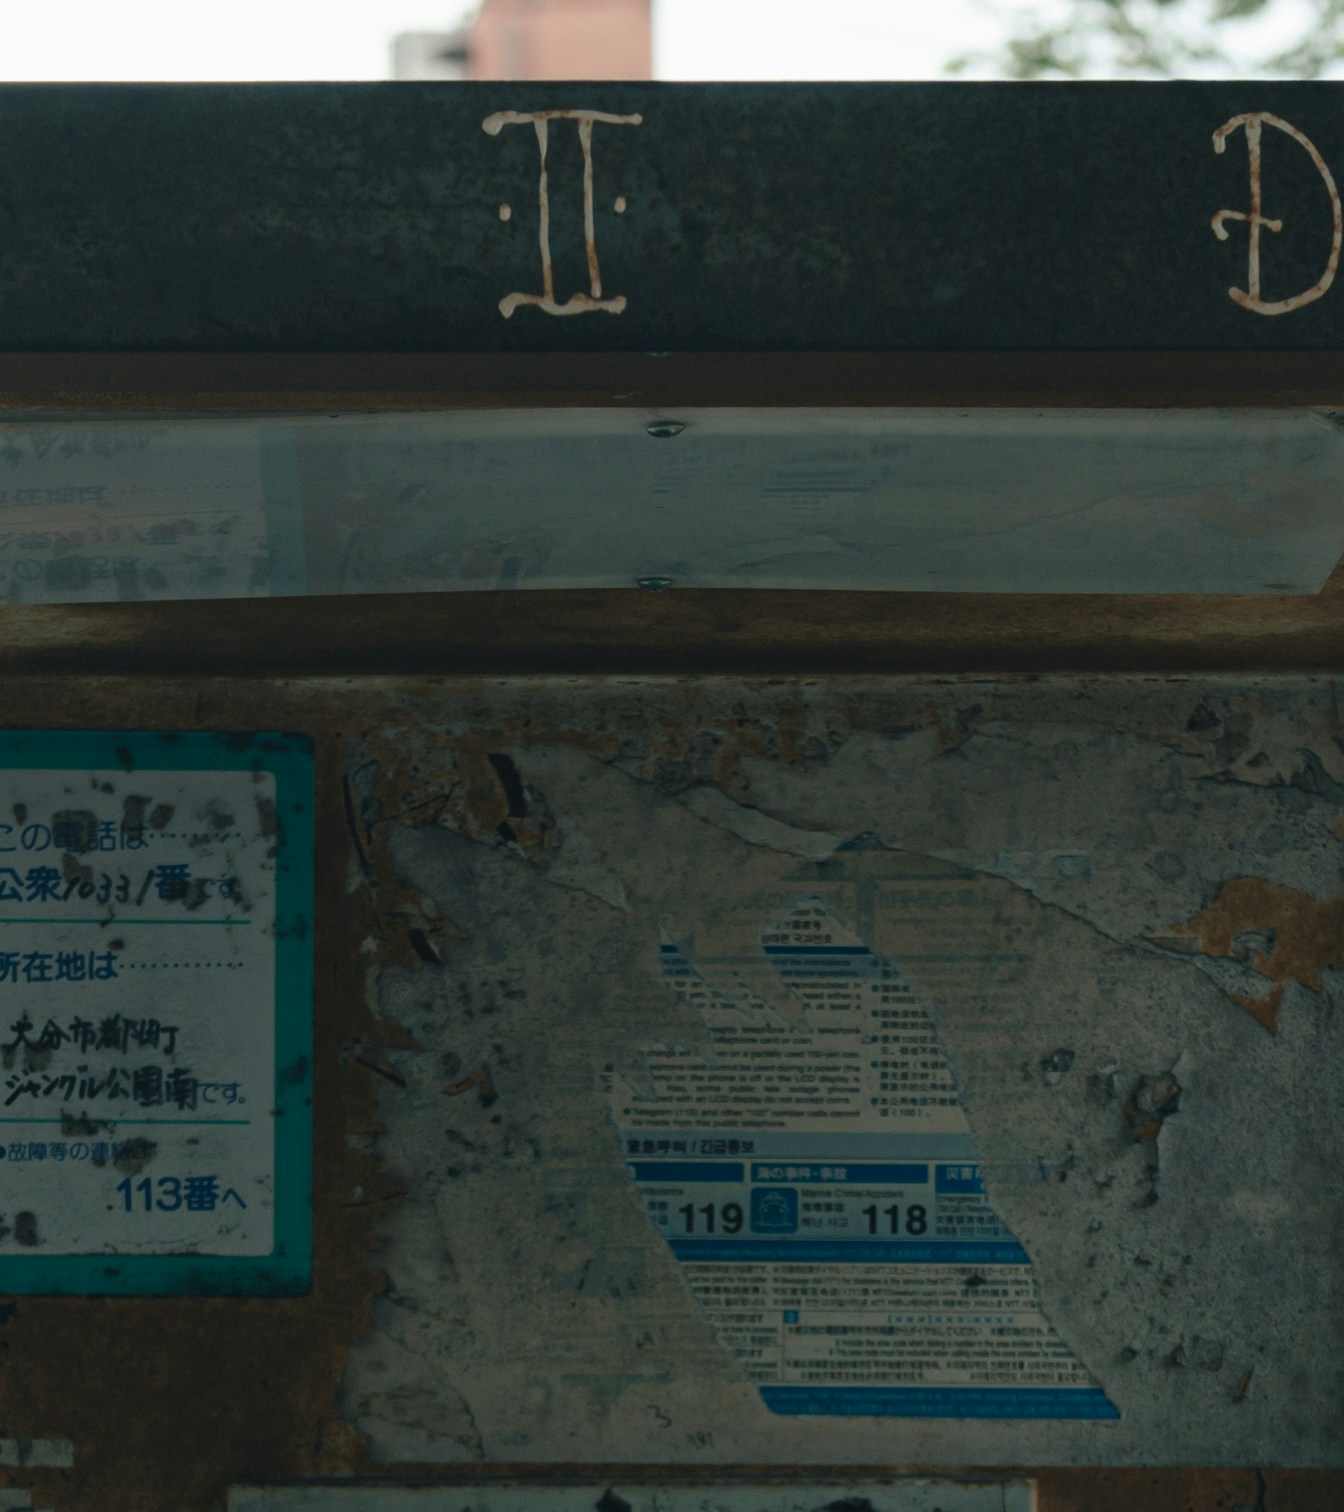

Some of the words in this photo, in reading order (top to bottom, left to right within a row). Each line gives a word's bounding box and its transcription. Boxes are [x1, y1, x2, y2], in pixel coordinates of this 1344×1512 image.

[116, 1174, 248, 1213] 113番へ
[678, 1202, 744, 1234] 119
[862, 1204, 927, 1236] 118
